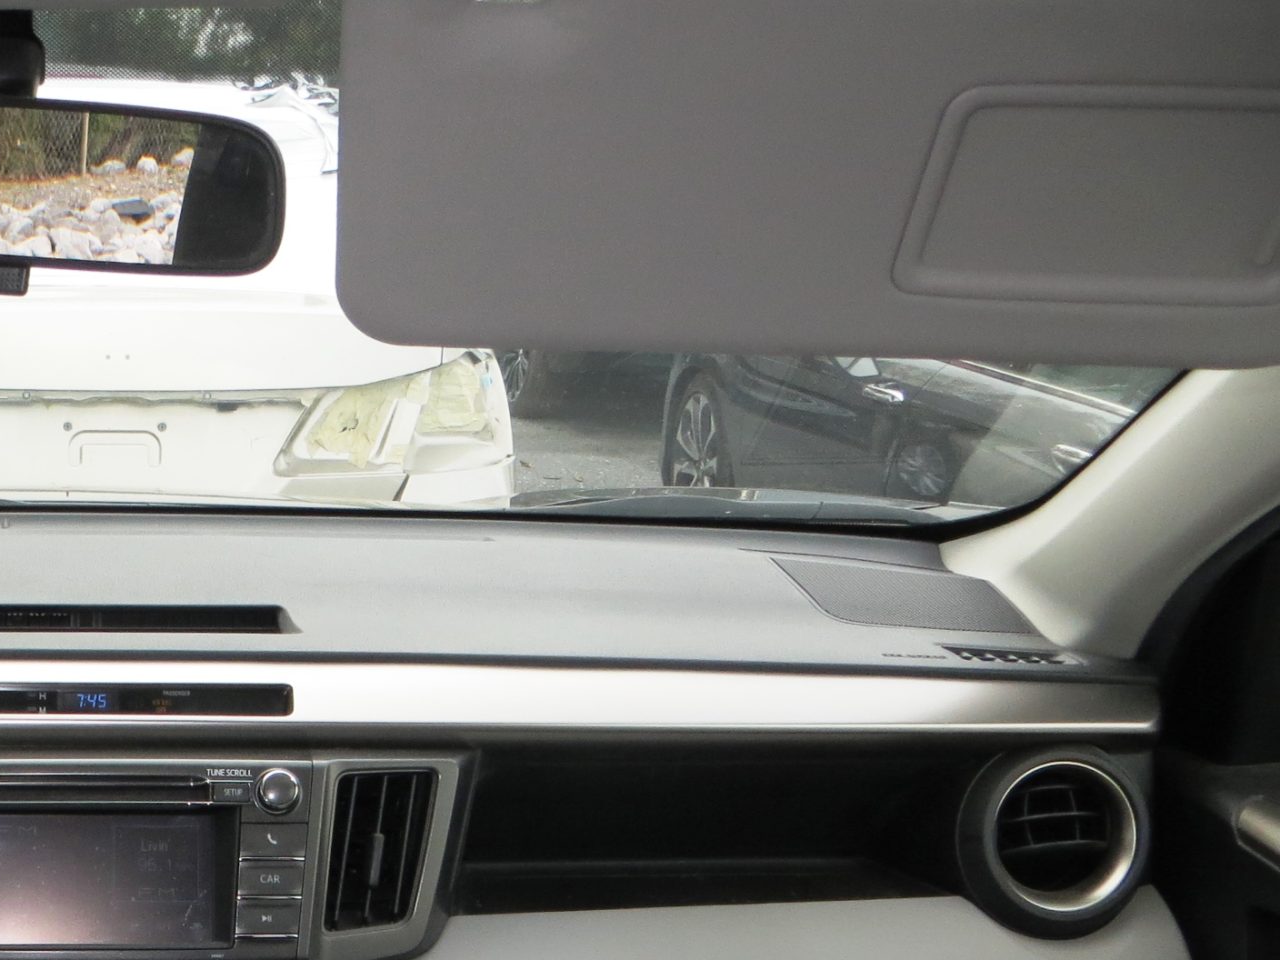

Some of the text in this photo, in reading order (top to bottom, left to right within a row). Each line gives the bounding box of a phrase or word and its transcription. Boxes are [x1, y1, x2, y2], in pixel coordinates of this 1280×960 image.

[39, 692, 47, 700] H
[77, 693, 107, 708] 7:45
[206, 768, 253, 777] TUNE SCROLL
[224, 788, 243, 796] SETUP
[260, 874, 281, 884] CAR
